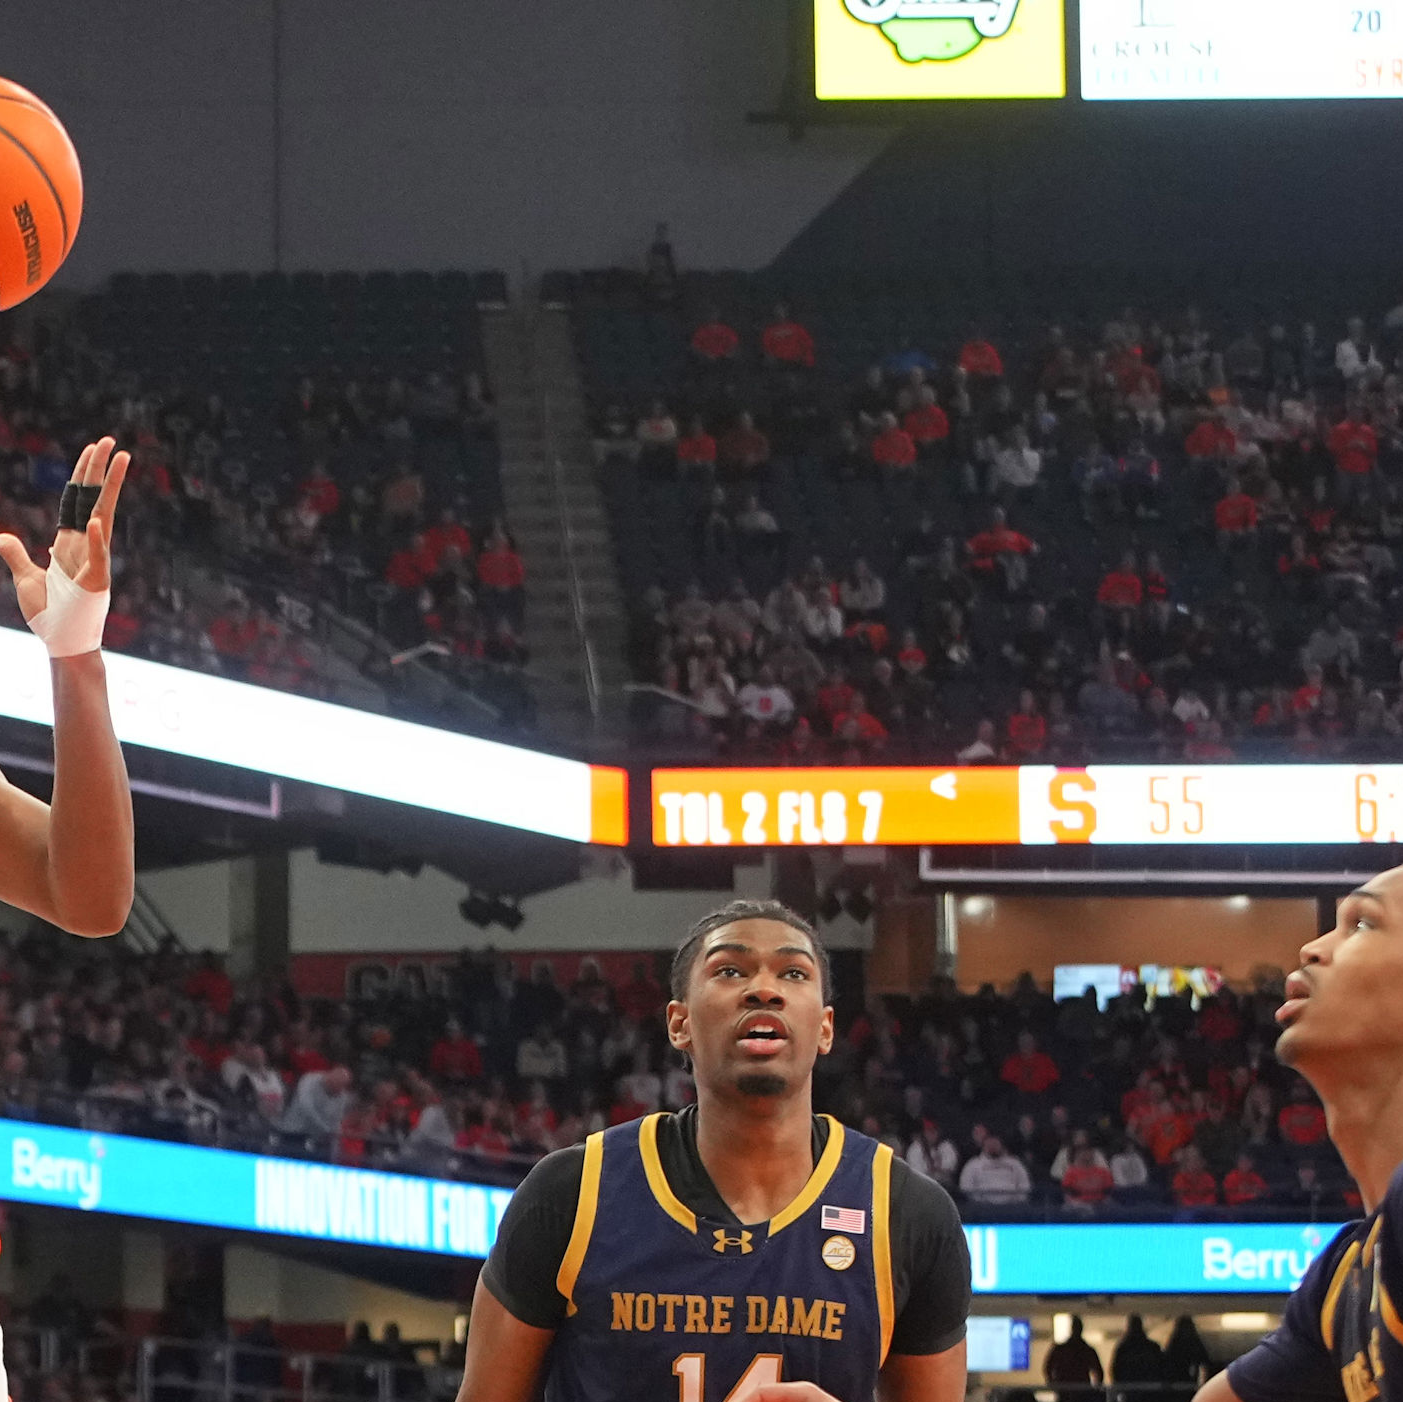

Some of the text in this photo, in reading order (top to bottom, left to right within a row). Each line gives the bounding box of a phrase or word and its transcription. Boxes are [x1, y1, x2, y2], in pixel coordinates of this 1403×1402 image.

[1351, 9, 1382, 34] 20
[740, 792, 767, 844] 2
[857, 792, 884, 844] 7
[1147, 775, 1204, 835] 55
[10, 1136, 101, 1211] Berry
[254, 1157, 429, 1245] INNOVATION
[431, 1180, 489, 1253] FOR
[610, 1291, 847, 1341] NOTRE DAME
